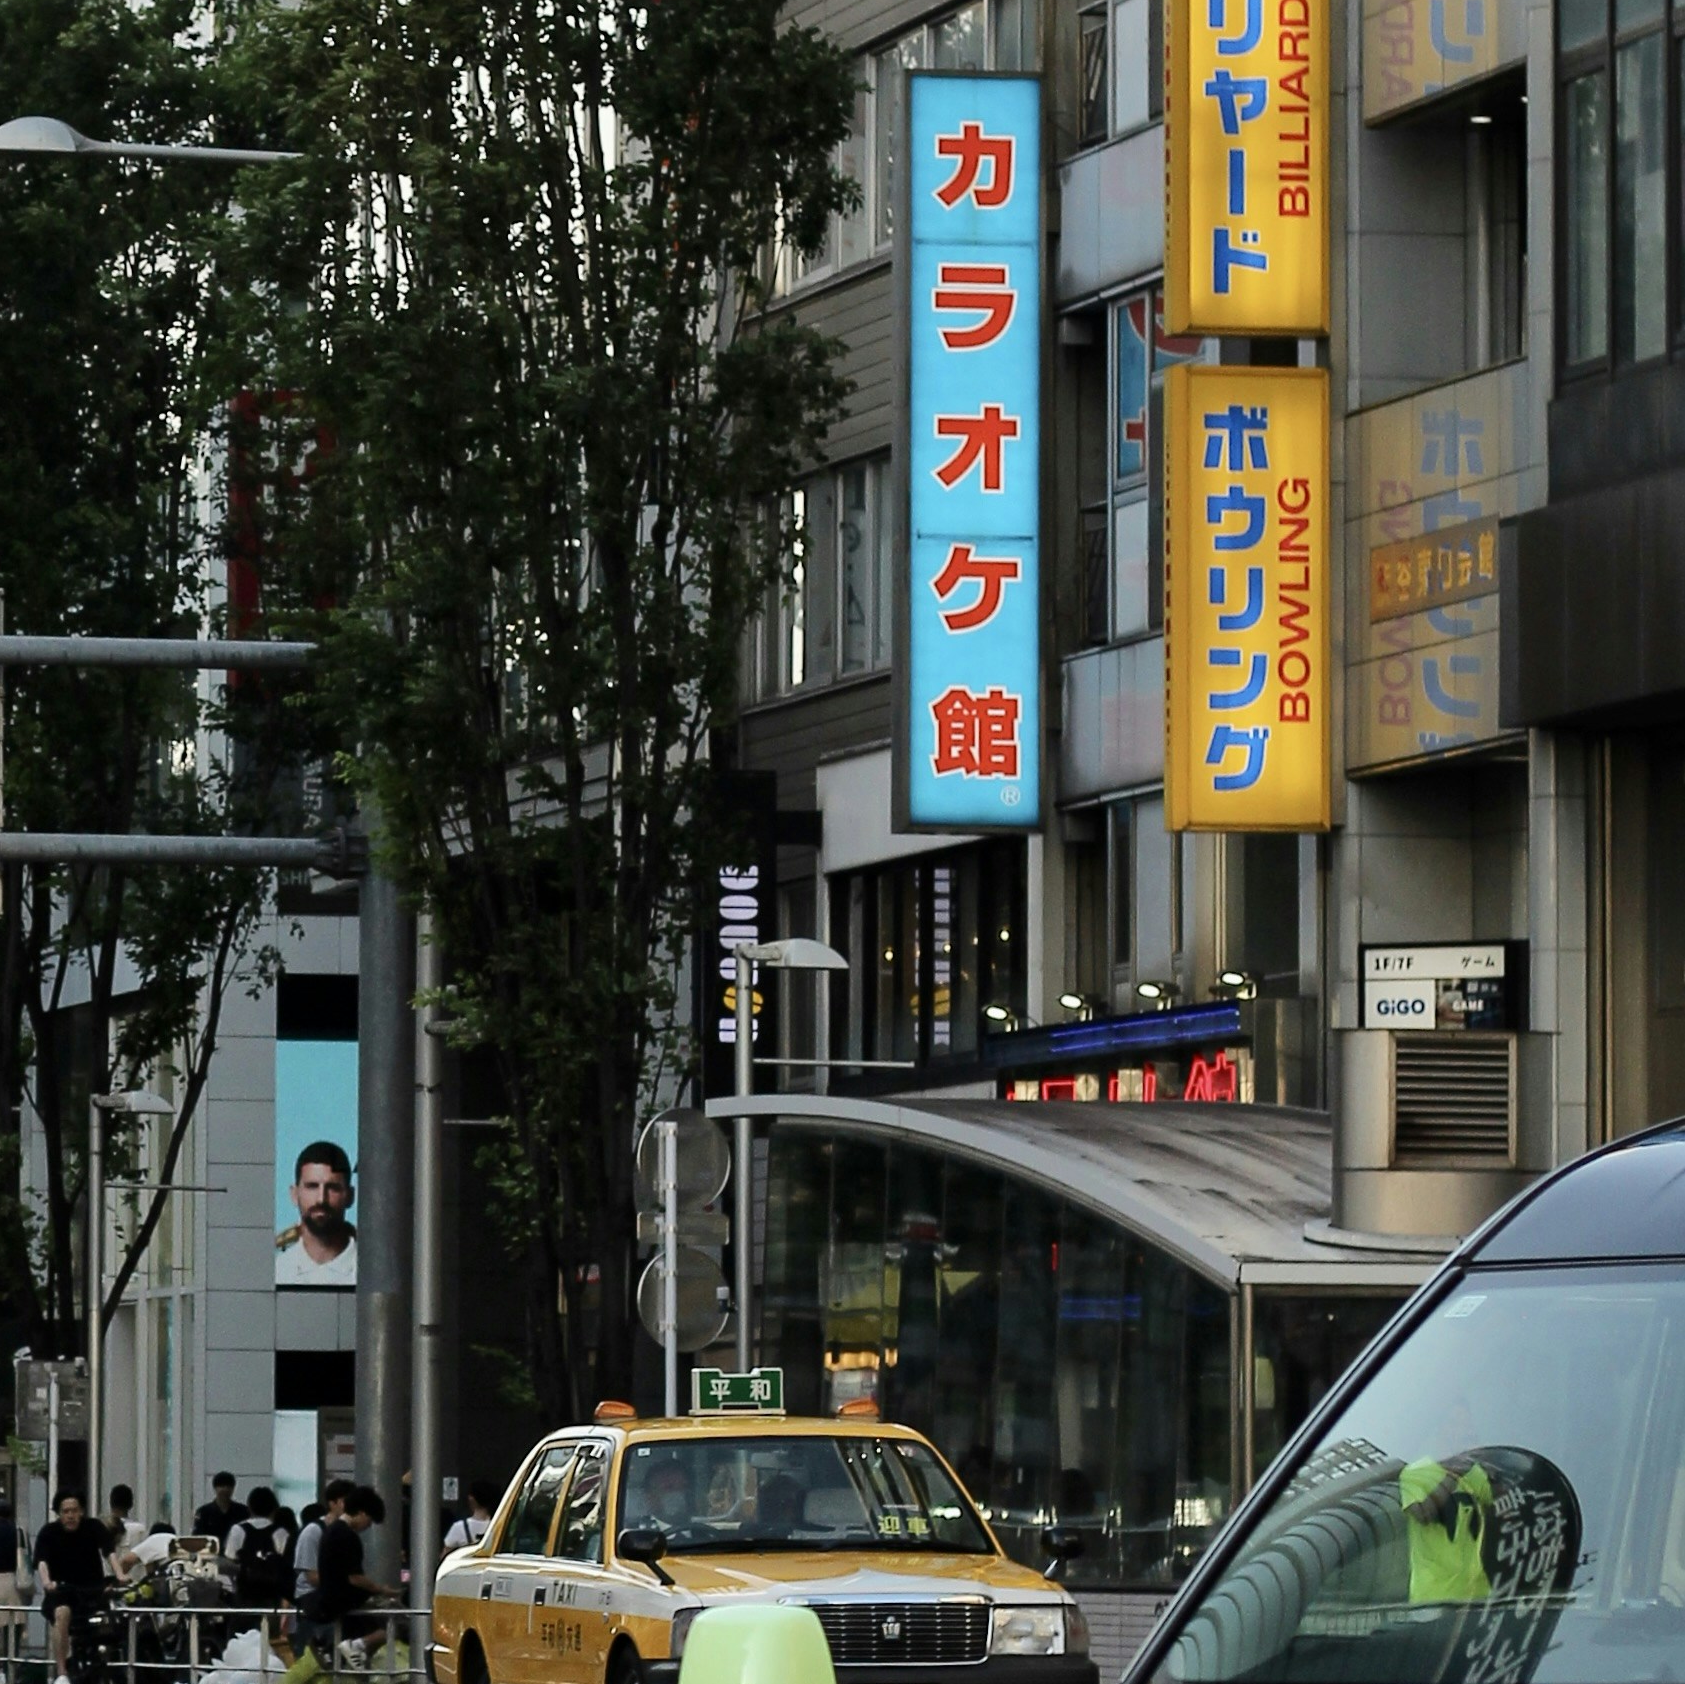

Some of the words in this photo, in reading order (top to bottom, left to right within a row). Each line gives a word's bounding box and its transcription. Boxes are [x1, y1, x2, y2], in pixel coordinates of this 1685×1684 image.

[932, 124, 1022, 779] カラオケ館
[1204, 404, 1271, 792] ボウリング
[1278, 478, 1311, 724] BOWLING
[1374, 957, 1414, 971] 1F/7F
[1376, 998, 1425, 1015] GiGO
[709, 1378, 771, 1402] 平和
[877, 1515, 931, 1537] 迎車
[552, 1579, 578, 1605] TAXI
